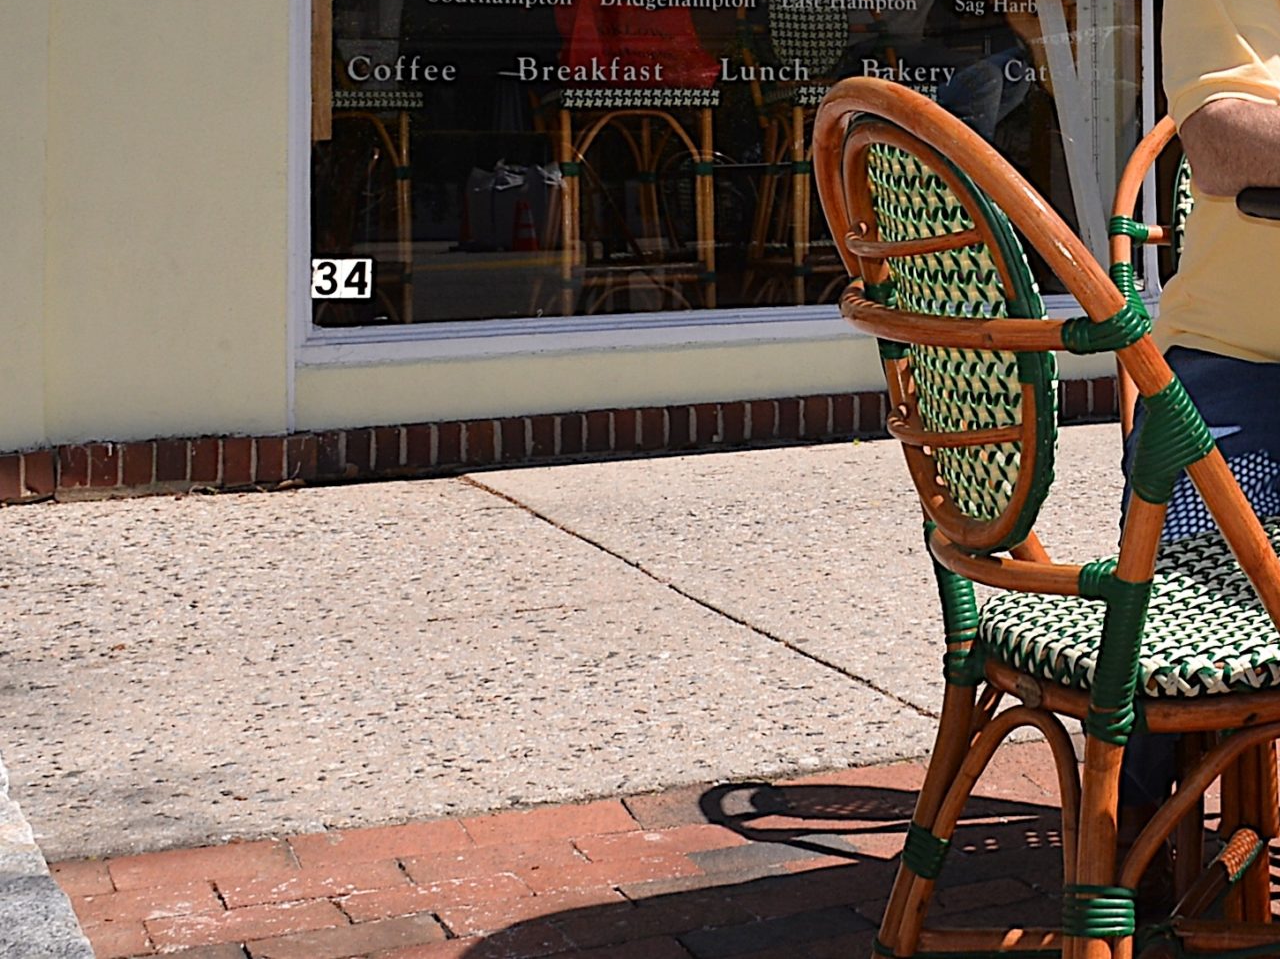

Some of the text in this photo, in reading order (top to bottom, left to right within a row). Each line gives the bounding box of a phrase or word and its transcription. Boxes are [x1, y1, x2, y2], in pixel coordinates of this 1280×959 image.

[347, 55, 457, 82] Coffee
[516, 57, 664, 82] Breakfast
[720, 57, 810, 82] Lunch
[861, 58, 956, 86] Bakery
[315, 261, 368, 296] 34
